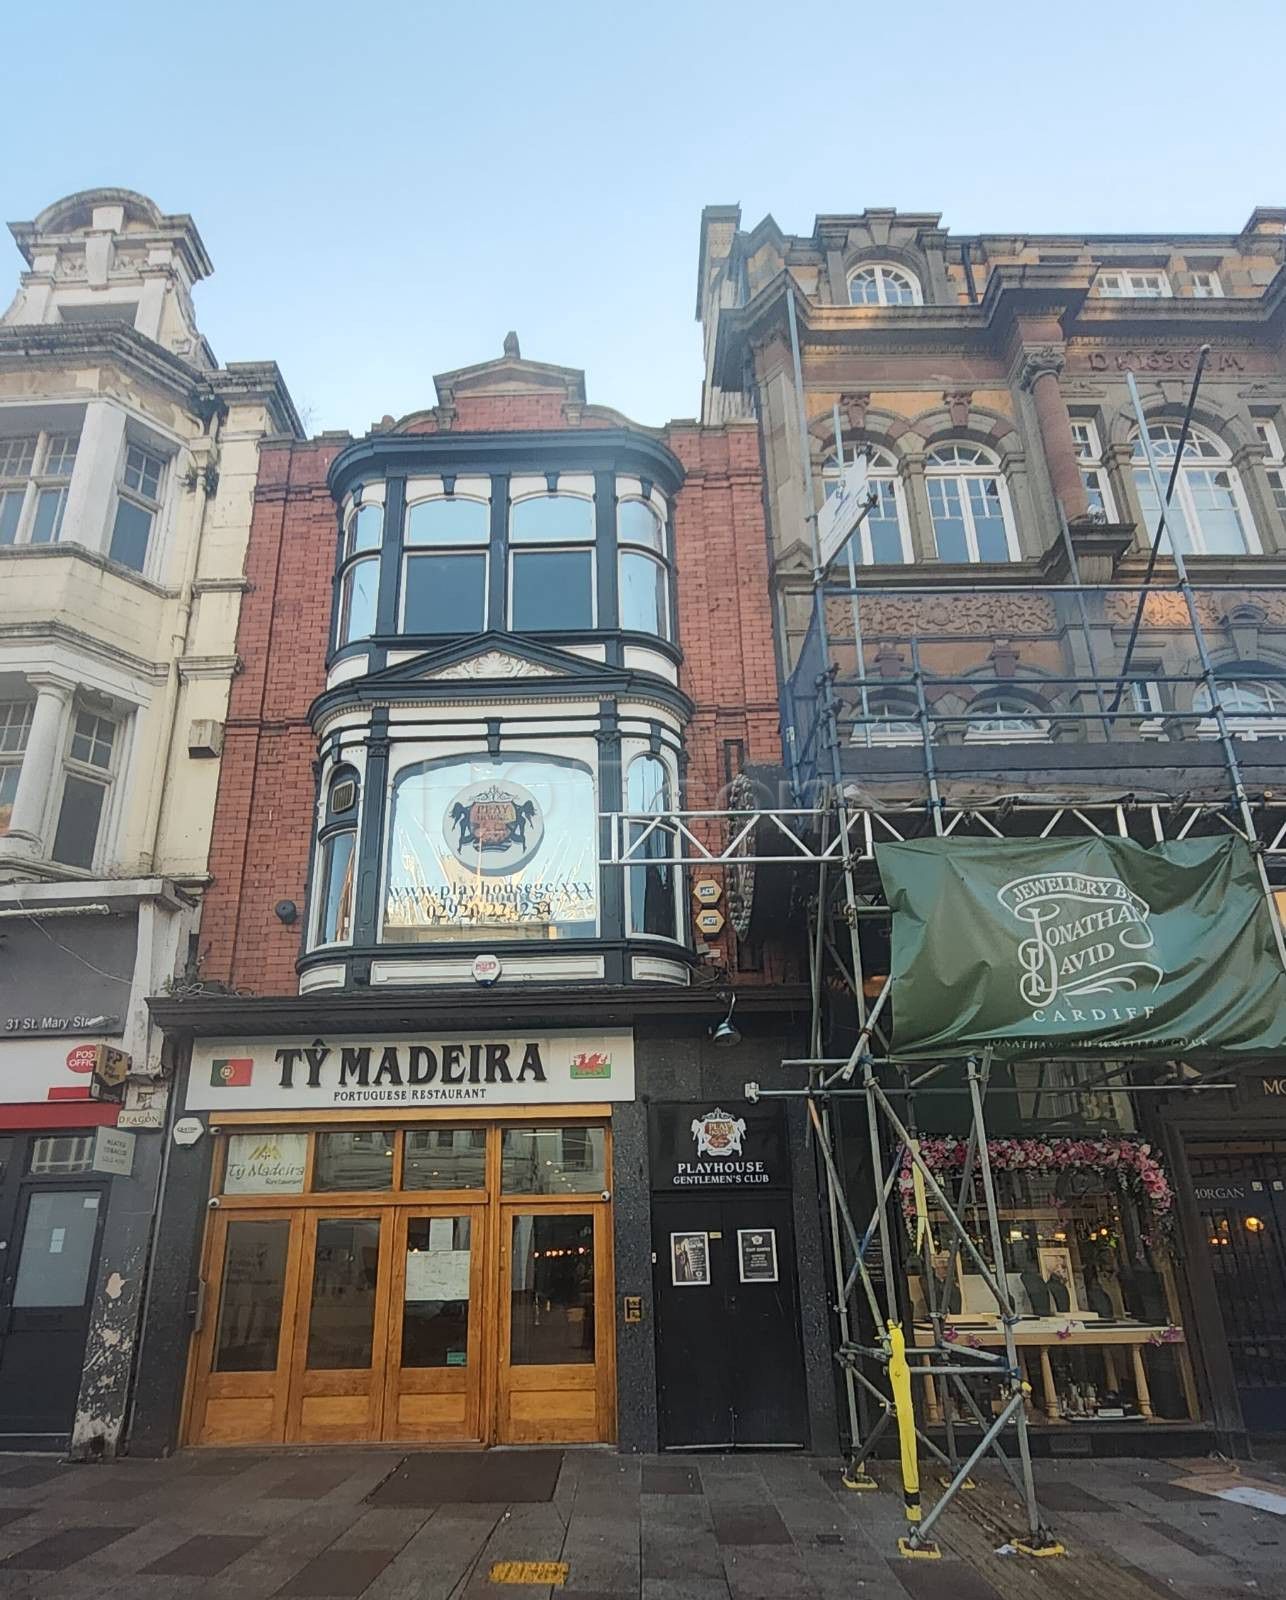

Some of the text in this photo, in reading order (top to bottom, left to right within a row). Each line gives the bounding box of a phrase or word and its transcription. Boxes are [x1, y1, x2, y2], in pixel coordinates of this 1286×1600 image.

[1012, 877, 1111, 902] JEWELLERY
[1033, 1006, 1155, 1022] CARDIFF
[6, 1018, 19, 1030] 31
[23, 1018, 37, 1030] St.
[42, 1016, 69, 1030] Mary
[69, 1059, 96, 1068] OFFIC
[338, 1043, 547, 1087] MADEIRA
[334, 1088, 487, 1101] PORTUGUESE RESTAURANT
[248, 1162, 304, 1177] Madeira
[678, 1161, 764, 1174] PLAYHOUSE
[673, 1174, 769, 1184] GENTLEMEN'S CLUB
